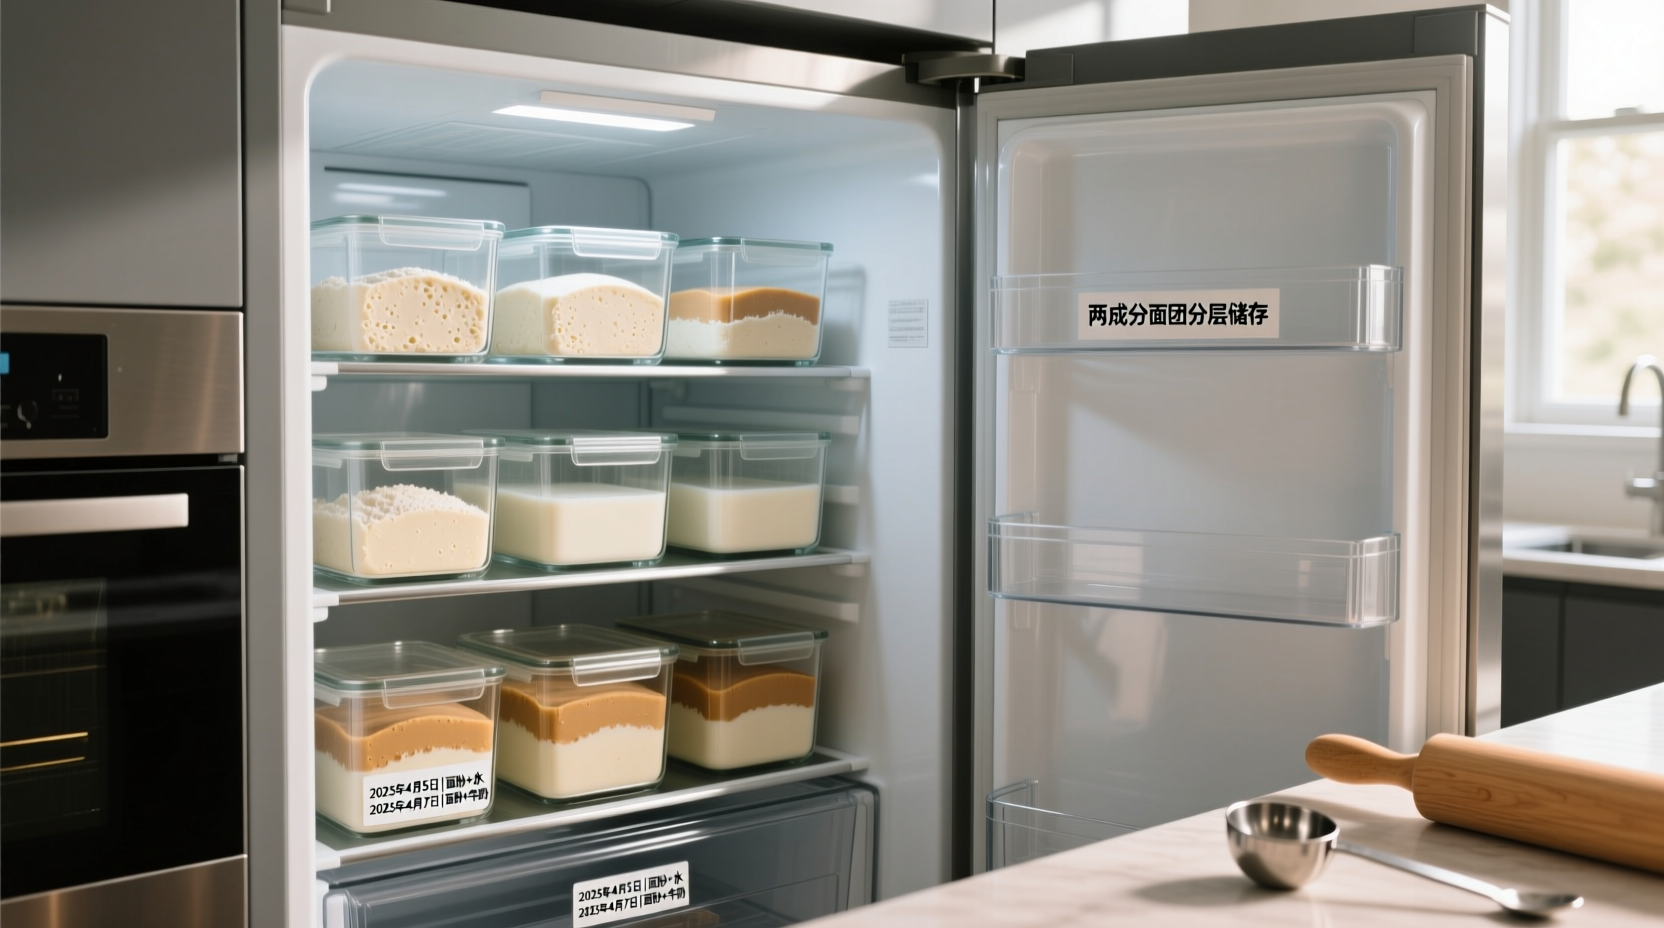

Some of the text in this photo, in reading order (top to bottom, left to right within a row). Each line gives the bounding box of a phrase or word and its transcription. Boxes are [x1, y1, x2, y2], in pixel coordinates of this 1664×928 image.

[1088, 302, 1269, 326] 两成分面团分层储存
